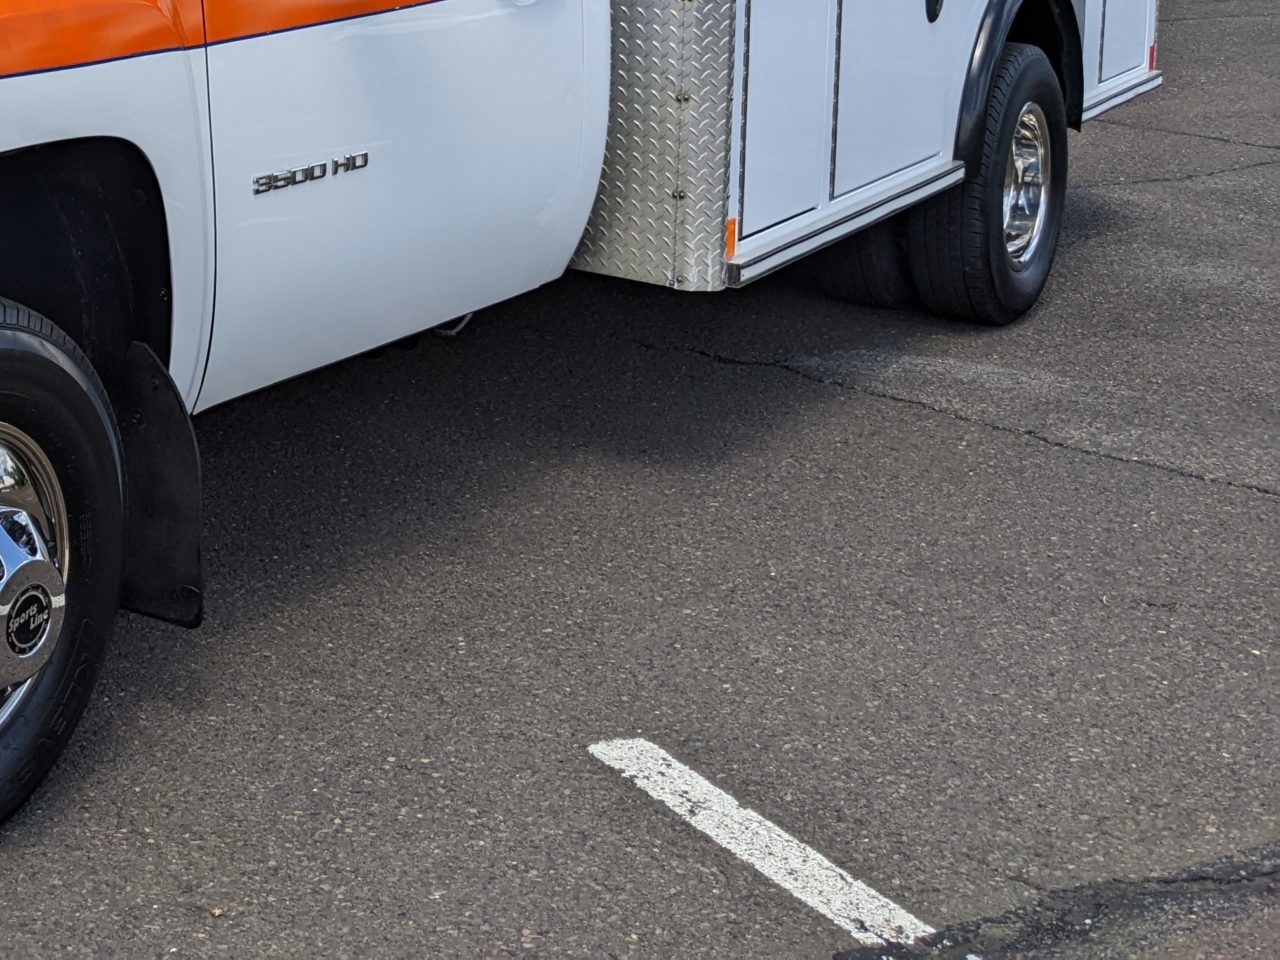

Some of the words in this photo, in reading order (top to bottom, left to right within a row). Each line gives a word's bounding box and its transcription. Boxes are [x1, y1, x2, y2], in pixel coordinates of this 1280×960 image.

[252, 160, 327, 196] 3500
[331, 150, 369, 176] HD
[8, 603, 38, 633] Sports
[29, 609, 49, 630] Line
